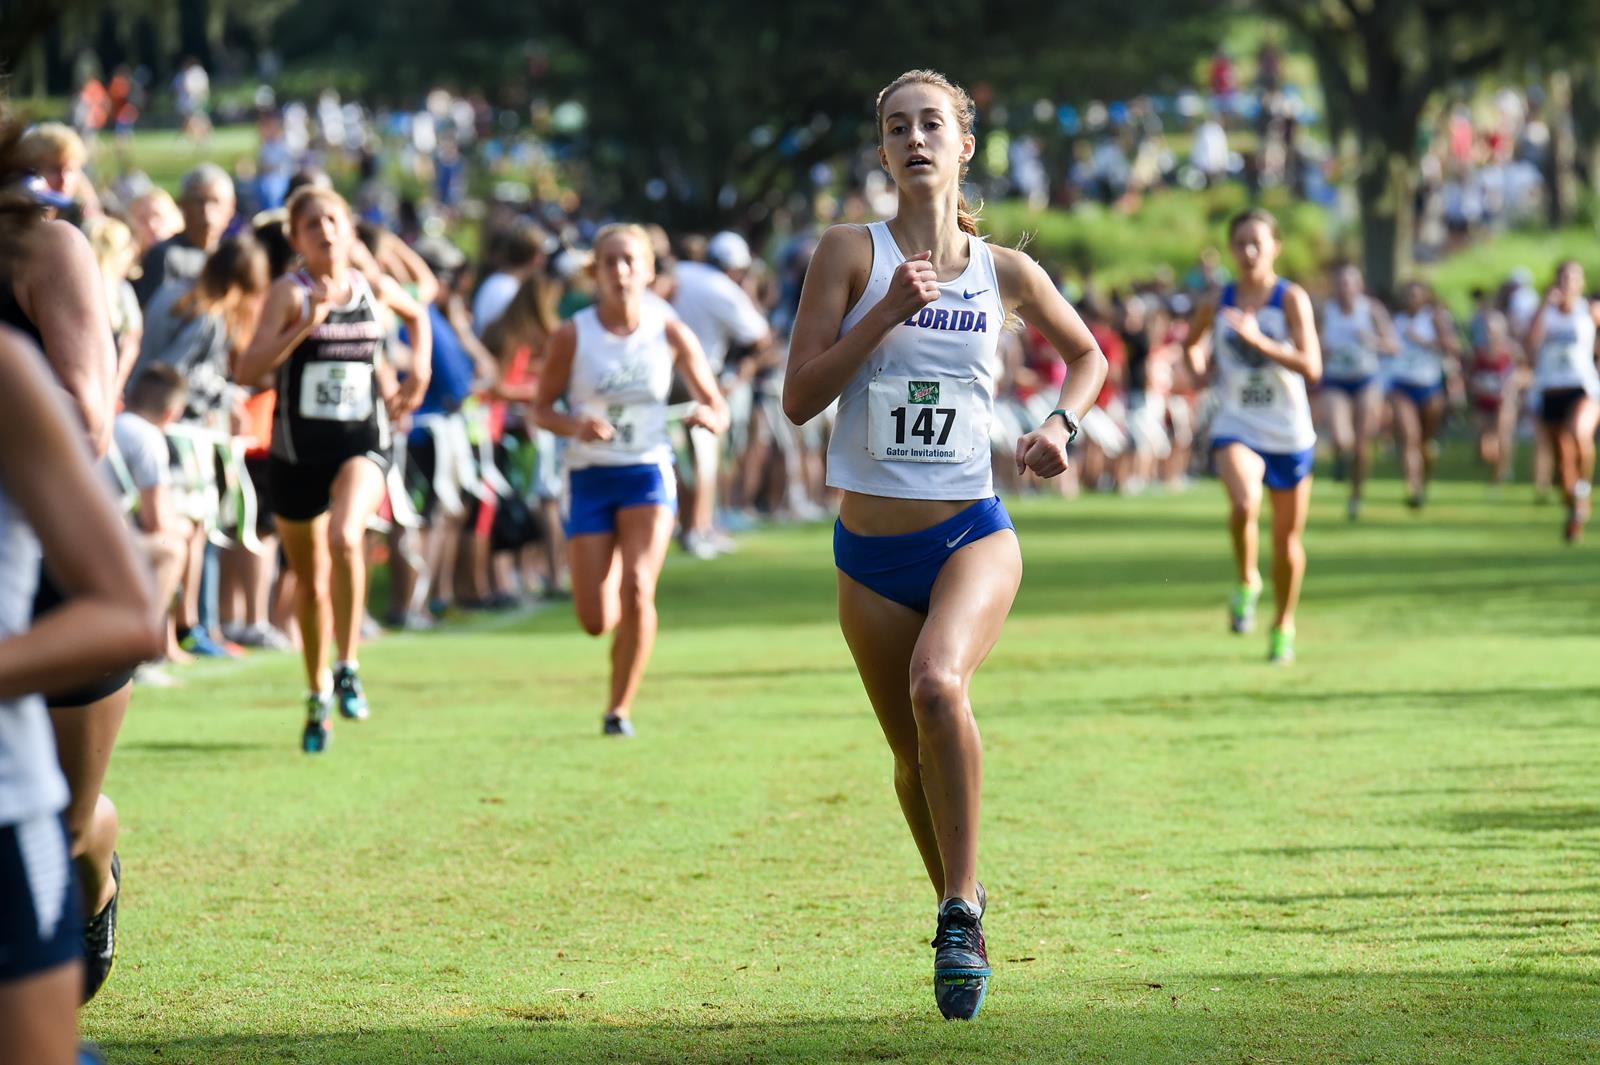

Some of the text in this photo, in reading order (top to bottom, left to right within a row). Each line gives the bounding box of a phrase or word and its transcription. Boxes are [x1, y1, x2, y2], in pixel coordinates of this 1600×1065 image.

[903, 307, 987, 333] LORIDA
[890, 406, 957, 446] 147
[886, 447, 956, 458] Gator Invitational
